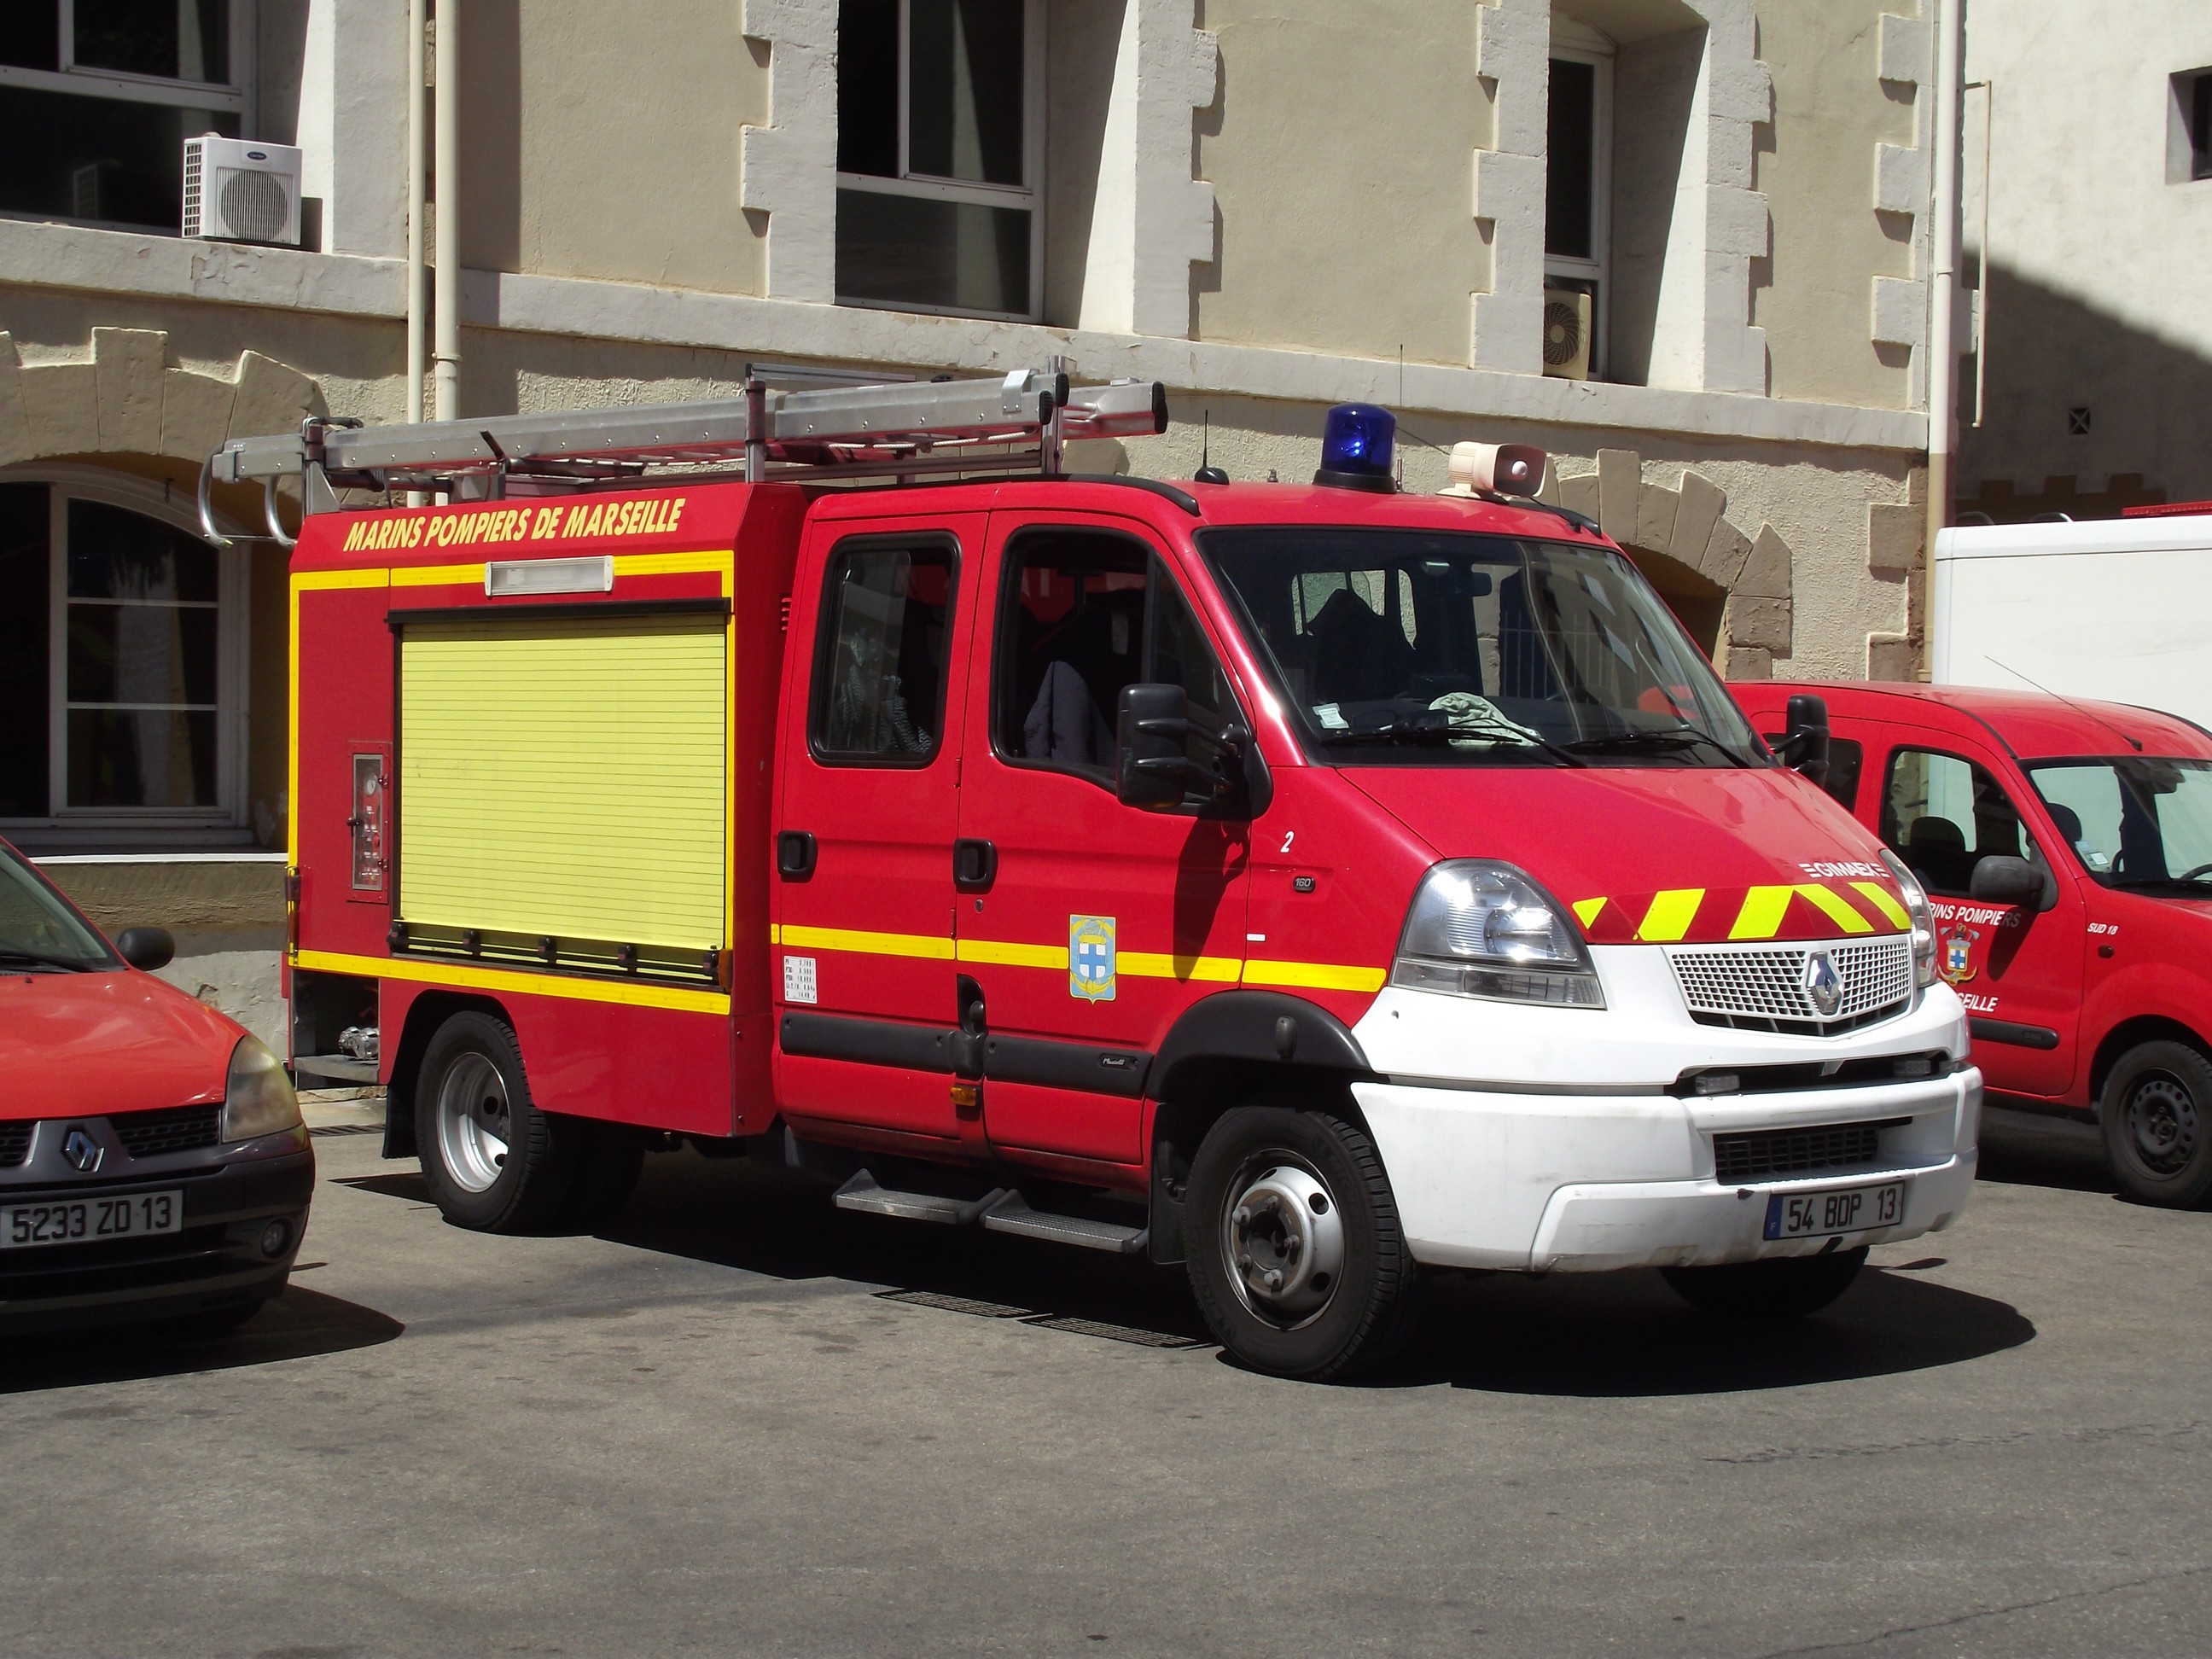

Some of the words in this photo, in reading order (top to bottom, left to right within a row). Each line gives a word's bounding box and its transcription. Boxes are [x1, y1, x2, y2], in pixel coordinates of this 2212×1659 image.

[342, 516, 426, 551] MARINS
[423, 507, 533, 547] POMPIERS
[531, 506, 560, 540] DE
[561, 498, 686, 538] MARSEILLE
[1280, 830, 1295, 853] 2
[1295, 877, 1312, 888] 160
[1955, 905, 2022, 928] POMPIERS
[2087, 923, 2106, 934] SUD
[2106, 924, 2119, 935] 18
[12, 1204, 86, 1243] 5233
[96, 1200, 131, 1235] ZD
[141, 1196, 172, 1230] 13
[1787, 1198, 1814, 1232] 54
[1824, 1193, 1862, 1229] BDP
[1877, 1187, 1897, 1222] 13
